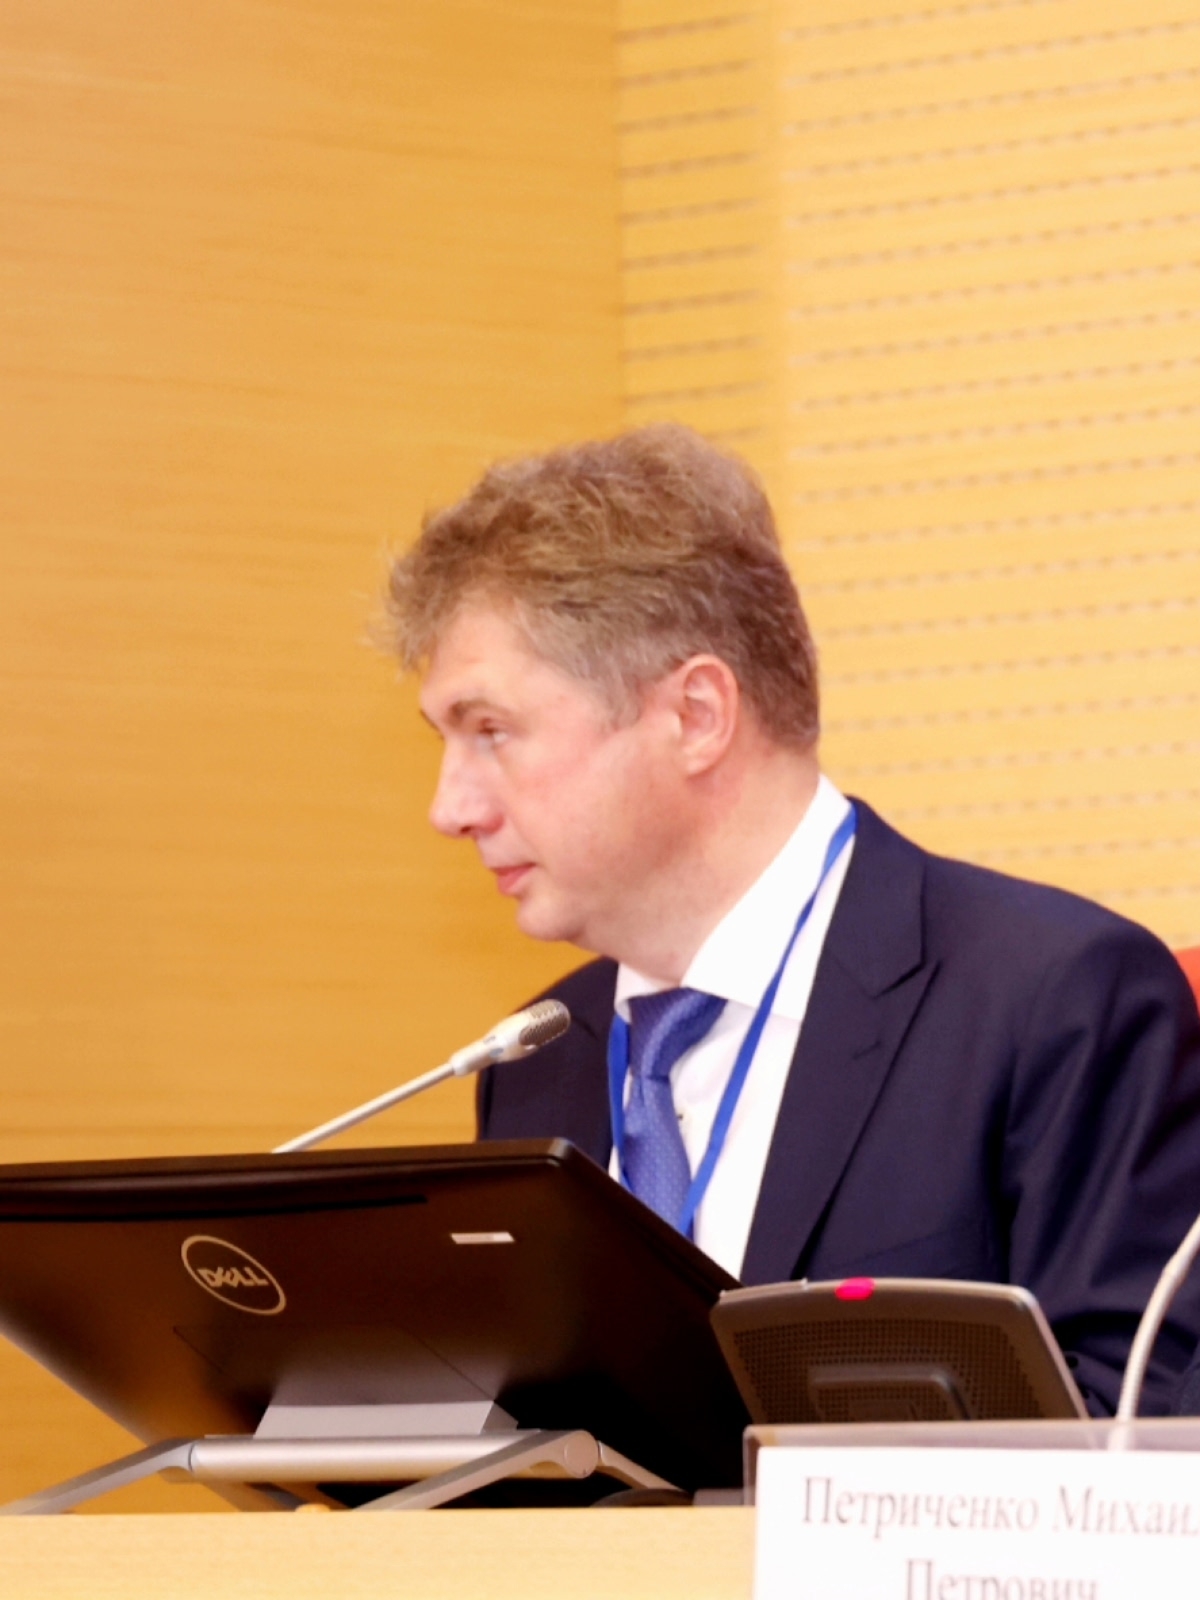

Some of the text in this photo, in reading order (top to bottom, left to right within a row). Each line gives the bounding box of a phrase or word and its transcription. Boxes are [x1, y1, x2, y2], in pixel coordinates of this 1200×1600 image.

[197, 1266, 269, 1288] DELL
[802, 1476, 1039, 1540] Петриченко
[905, 1558, 1098, 1600] Петрович
